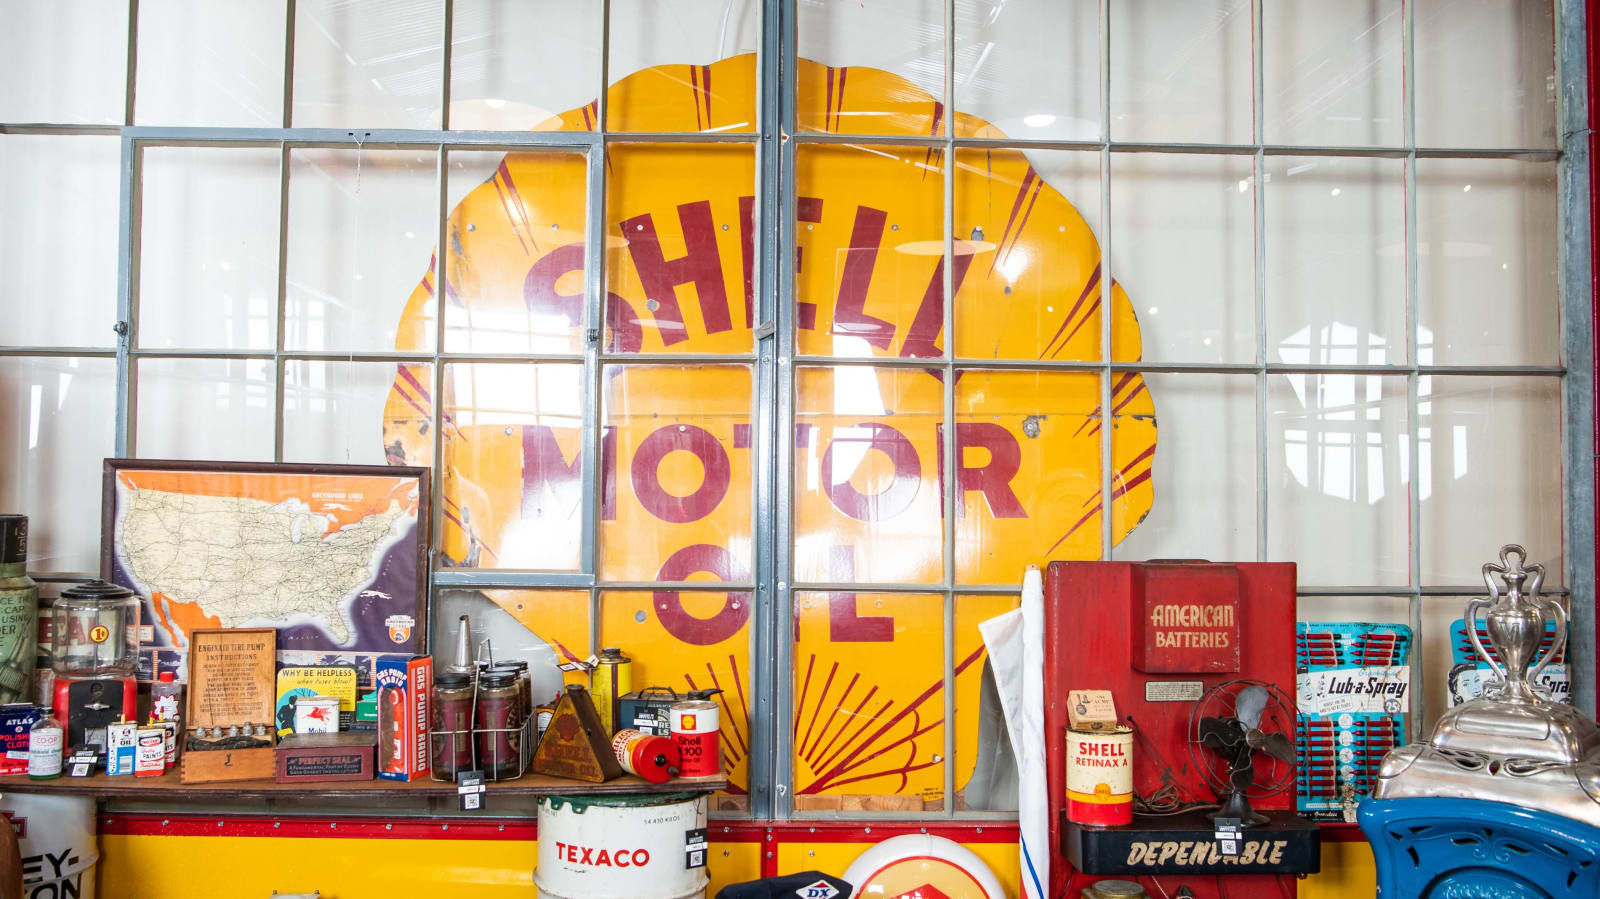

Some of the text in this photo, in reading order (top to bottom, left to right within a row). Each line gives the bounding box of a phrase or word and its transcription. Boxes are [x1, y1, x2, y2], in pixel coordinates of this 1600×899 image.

[523, 194, 977, 386] SHELL
[652, 543, 895, 647] OL
[1150, 604, 1234, 628] AMERICAN
[1155, 631, 1229, 649] BATTERIES
[246, 642, 266, 651] PUMP
[206, 653, 257, 661] INSTRUCTIONS
[282, 669, 352, 677] WHY BE HELPLESS
[376, 668, 407, 680] GAS PUMP
[381, 676, 404, 686] RADIO
[6, 717, 34, 726] ATLAS
[416, 666, 426, 771] GAS PUMP RADIO
[678, 736, 701, 746] Shell
[1079, 741, 1125, 757] SHELL
[143, 751, 162, 759] PAINTS
[1075, 757, 1128, 768] RETINAX A
[556, 841, 650, 868] TEXACO
[807, 888, 831, 898] DX
